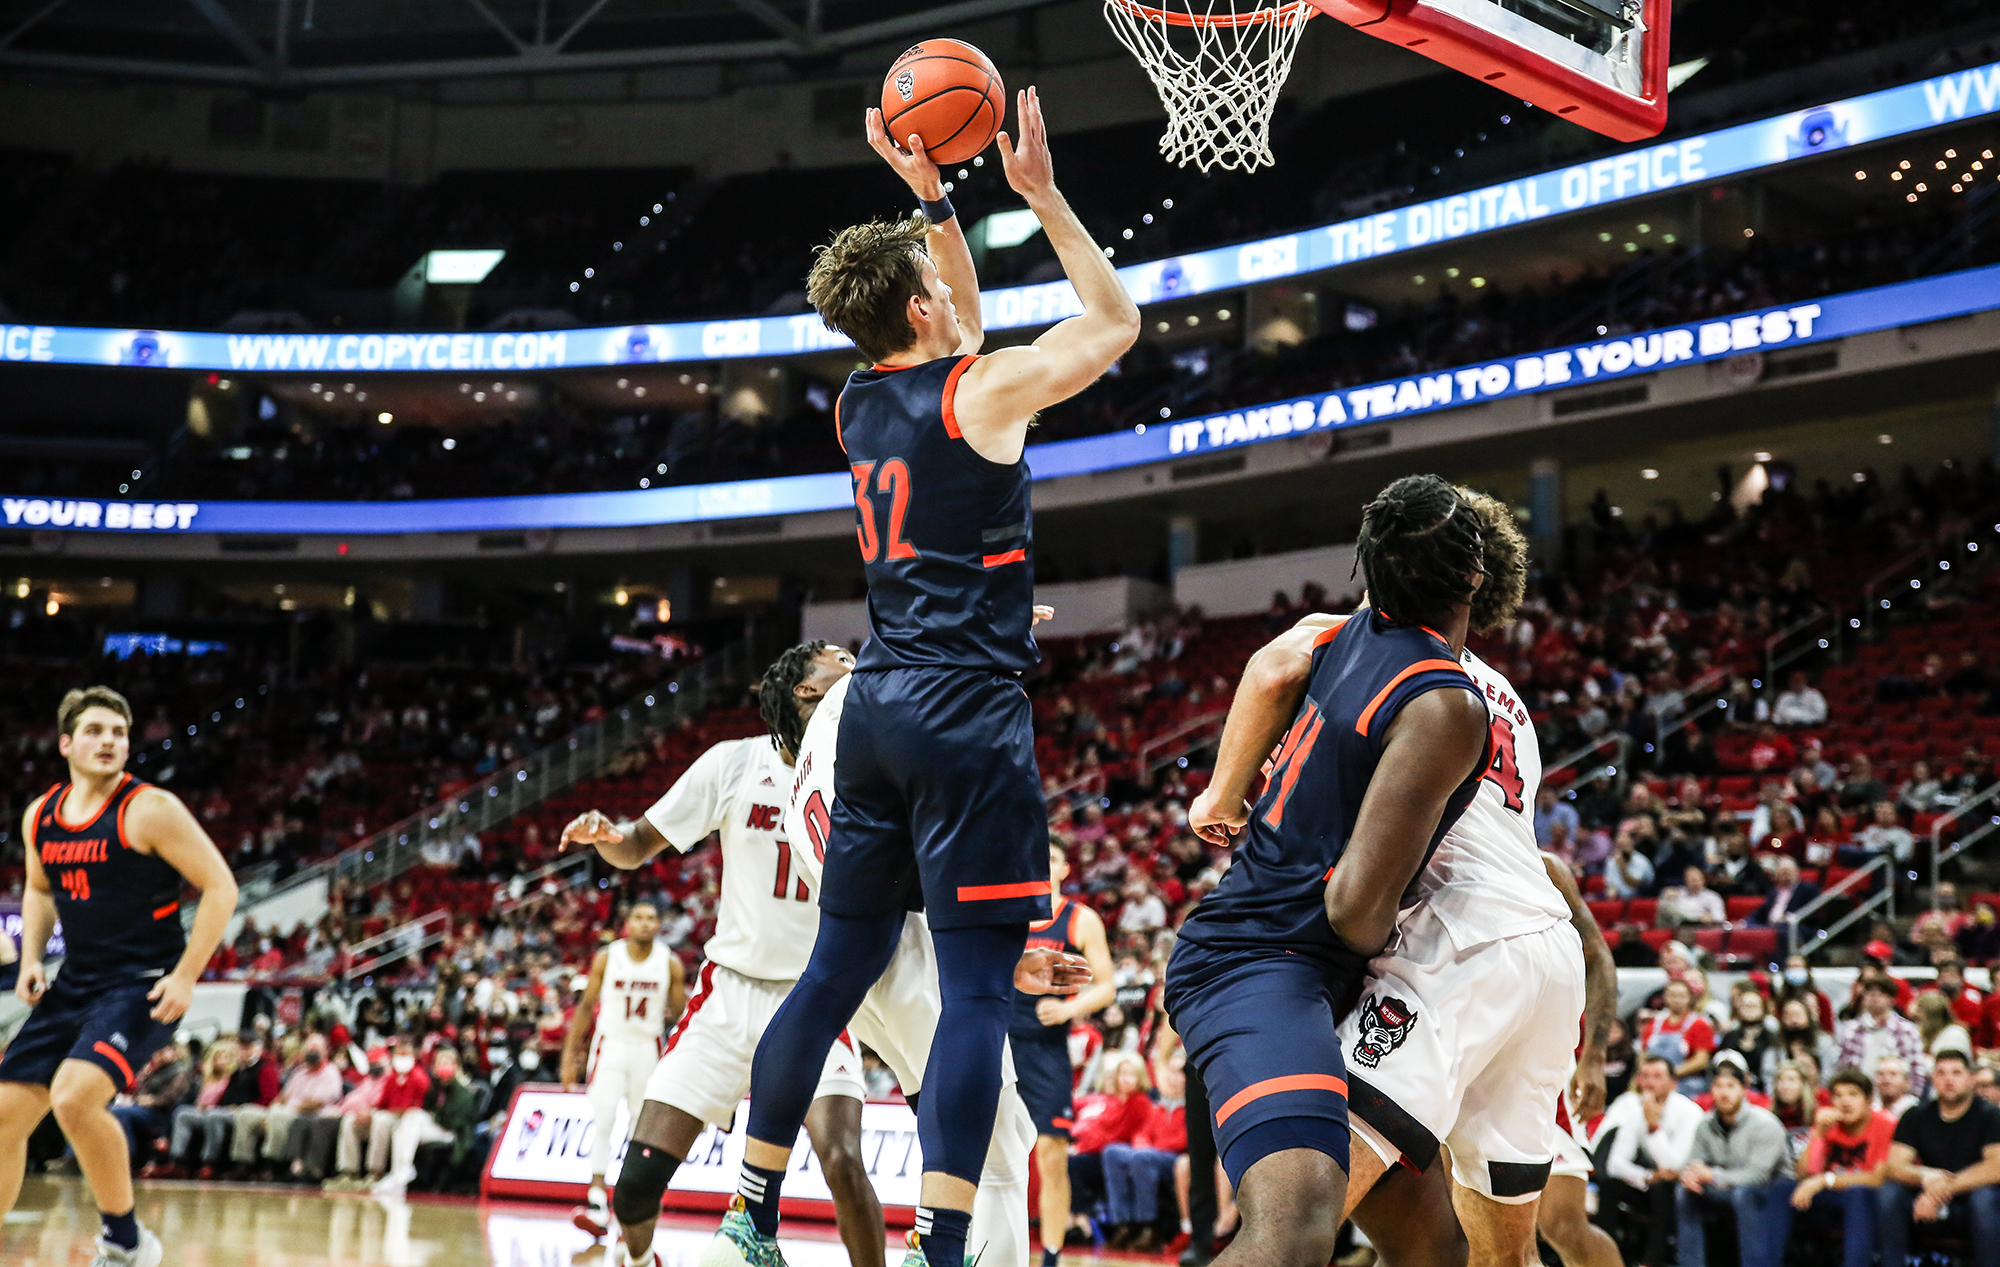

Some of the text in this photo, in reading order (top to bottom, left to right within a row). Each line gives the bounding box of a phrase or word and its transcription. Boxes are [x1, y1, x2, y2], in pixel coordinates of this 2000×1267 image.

[1326, 211, 1397, 263] THE
[1406, 177, 1551, 248] DIGITAL
[1561, 137, 1707, 210] OFFICE
[227, 333, 567, 369] WWW.COPYCEI.COM
[1168, 420, 1205, 454] IT
[1205, 400, 1316, 447] TAKES
[1317, 394, 1347, 427] A
[1347, 373, 1453, 420] TEAM
[1454, 363, 1511, 400] TO
[1514, 351, 1572, 391] BE
[1576, 328, 1694, 378] YOUR
[1699, 303, 1821, 356] BEST
[2, 498, 199, 529] YOUR BEST
[851, 457, 922, 565] 32
[746, 803, 781, 831] NC
[625, 996, 647, 1020] 14
[1386, 1011, 1402, 1025] STATE
